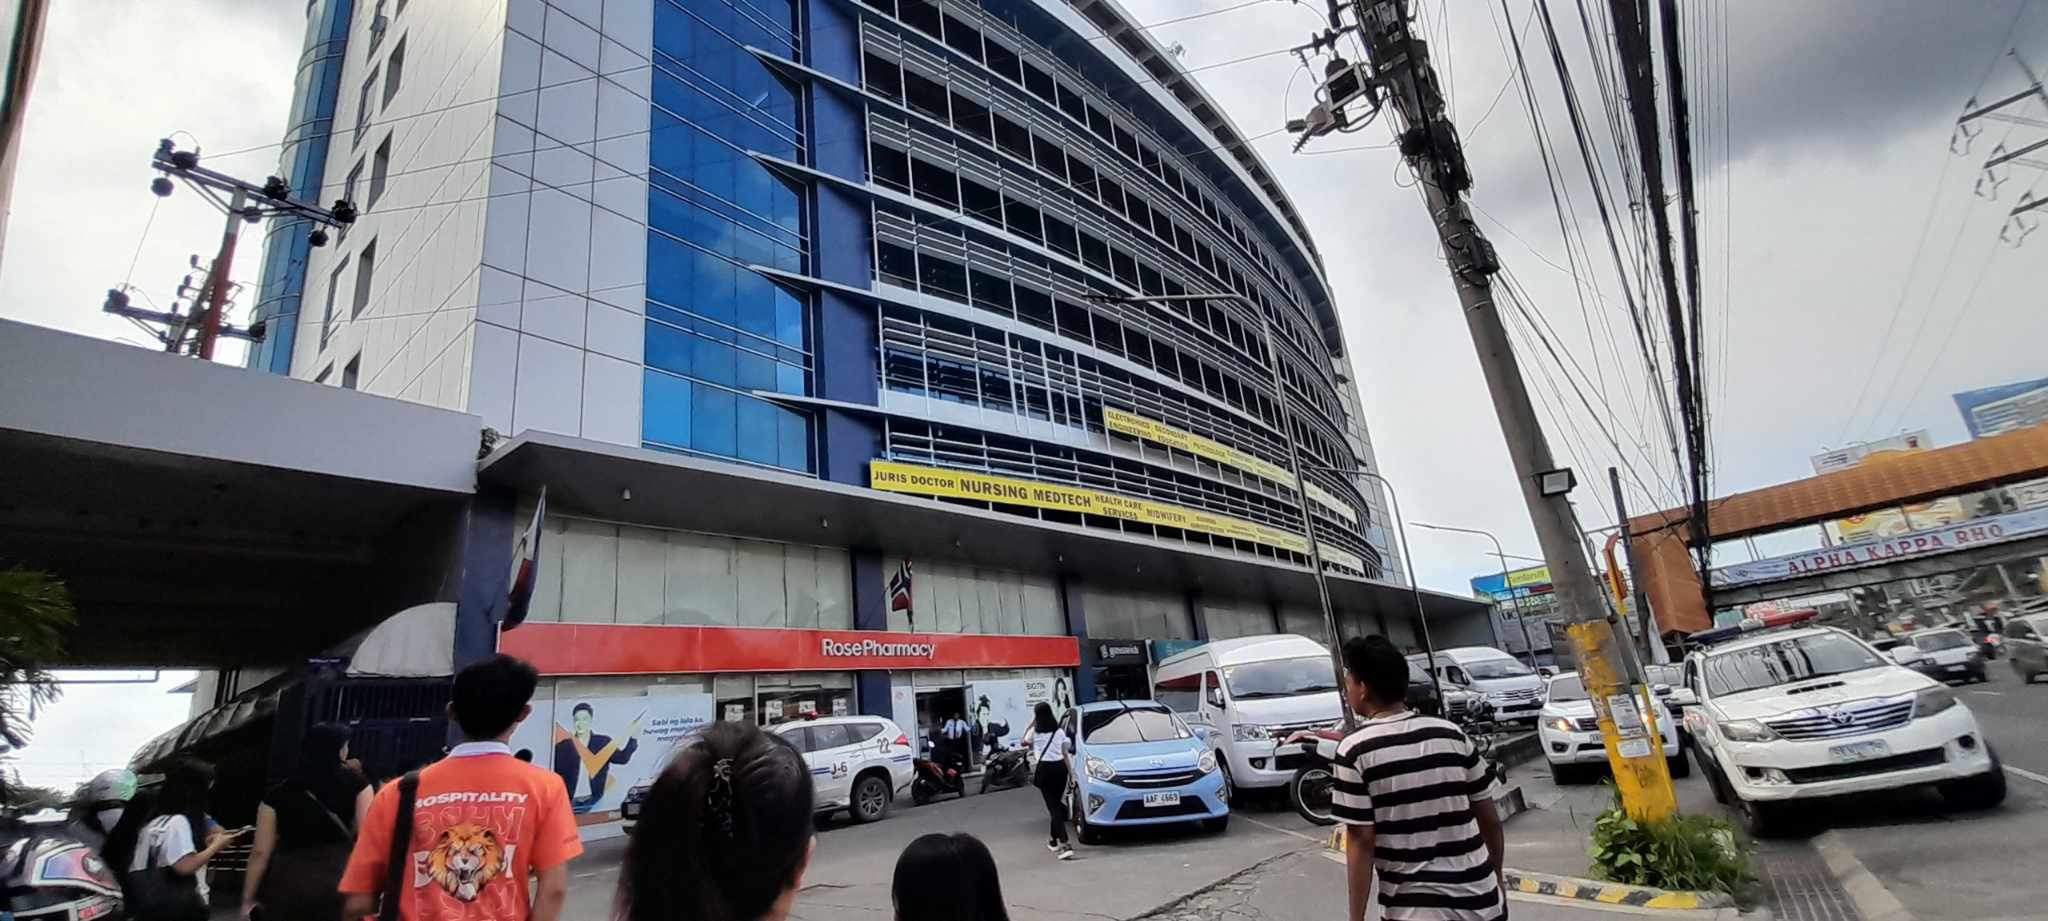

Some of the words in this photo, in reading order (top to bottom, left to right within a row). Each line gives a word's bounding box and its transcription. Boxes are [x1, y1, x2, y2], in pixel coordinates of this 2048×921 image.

[874, 471, 907, 484] JURIS
[910, 475, 955, 489] DOCTOR
[960, 479, 1028, 500] NURSING
[1033, 488, 1092, 507] MEDTECH
[1095, 494, 1123, 507] HEALTH
[1125, 498, 1143, 510] CARE
[1103, 507, 1138, 520] SERVICES
[1146, 508, 1186, 523] MIDWIFERY
[1788, 552, 1858, 576] ALPHA
[1866, 536, 1944, 562] KAPPA
[1955, 523, 2004, 546] RHO
[877, 737, 892, 753] 22
[831, 761, 848, 775] J-6
